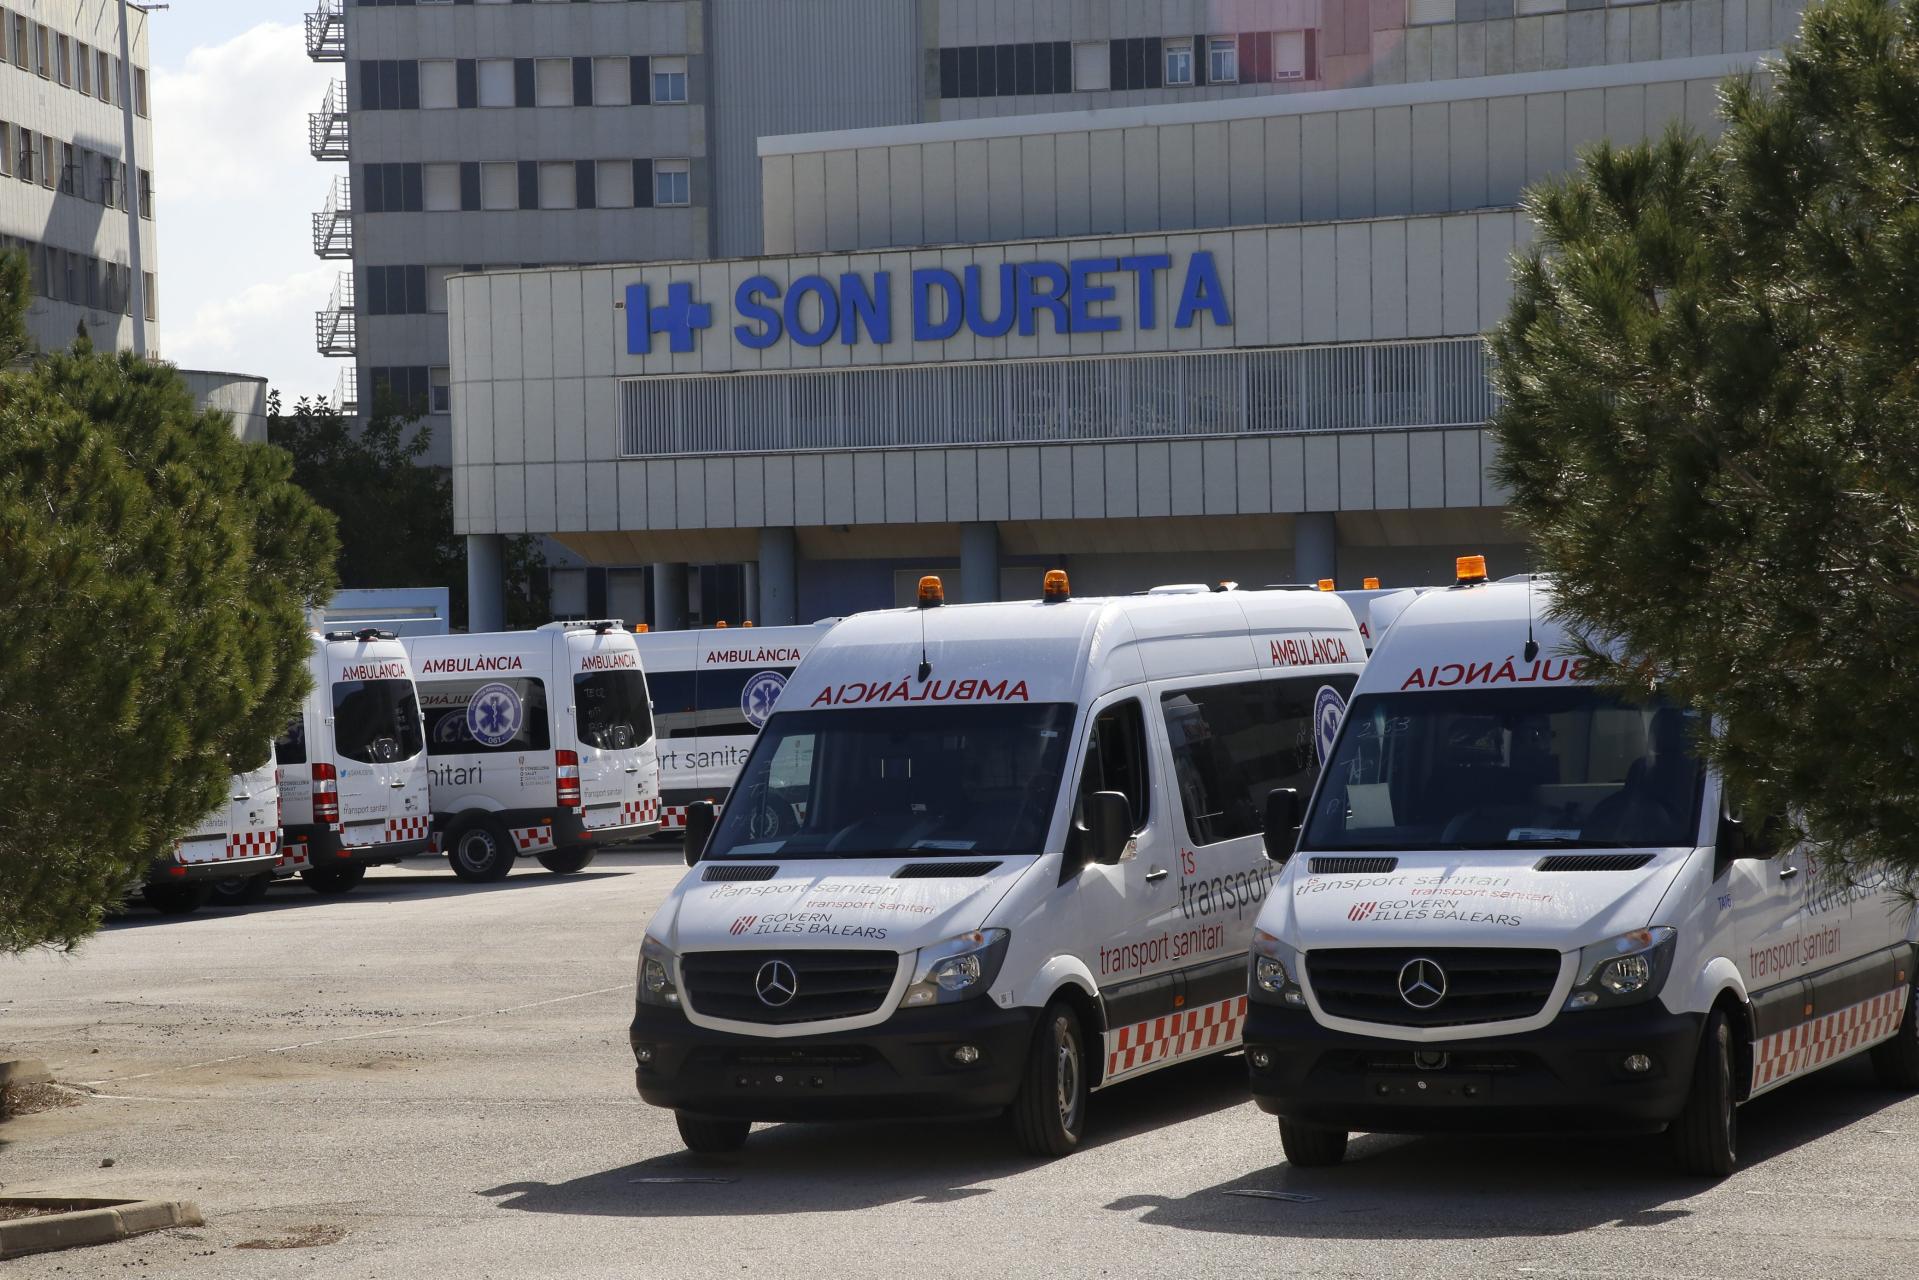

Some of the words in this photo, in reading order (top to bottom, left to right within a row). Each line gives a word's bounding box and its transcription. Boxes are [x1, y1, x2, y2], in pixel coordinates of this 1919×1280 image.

[733, 271, 893, 350] SON
[913, 250, 1232, 343] DURETA
[706, 646, 800, 664] AMBULÀNCIA
[1270, 636, 1349, 666] AMBULÀNCIA
[342, 661, 406, 681] AMBULÀNCIA
[422, 654, 523, 673] AMBULÀNCIA
[581, 653, 637, 671] AMBULÀNCIA
[685, 745, 750, 769] sanita
[427, 760, 482, 787] nitari
[1180, 847, 1196, 876] ts
[710, 882, 810, 899] transport
[814, 882, 900, 896] sanitari
[1180, 860, 1278, 920] transport
[1296, 876, 1408, 896] transport
[1414, 876, 1511, 887] sanitari
[1411, 888, 1487, 896] transport
[1490, 888, 1553, 903] sanitari
[806, 900, 875, 910] transport
[878, 901, 936, 914] sanitari
[1380, 899, 1459, 910] GOVERN
[761, 912, 833, 924] GOVERN
[1372, 909, 1428, 921] ILLES
[1433, 909, 1522, 927] BALEARS
[753, 922, 805, 936] ILLES
[808, 923, 888, 940] BALEARS
[1100, 931, 1169, 975] transport
[1173, 921, 1224, 958] sanitari
[1749, 932, 1800, 981] transport
[1803, 919, 1841, 961] sanitari
